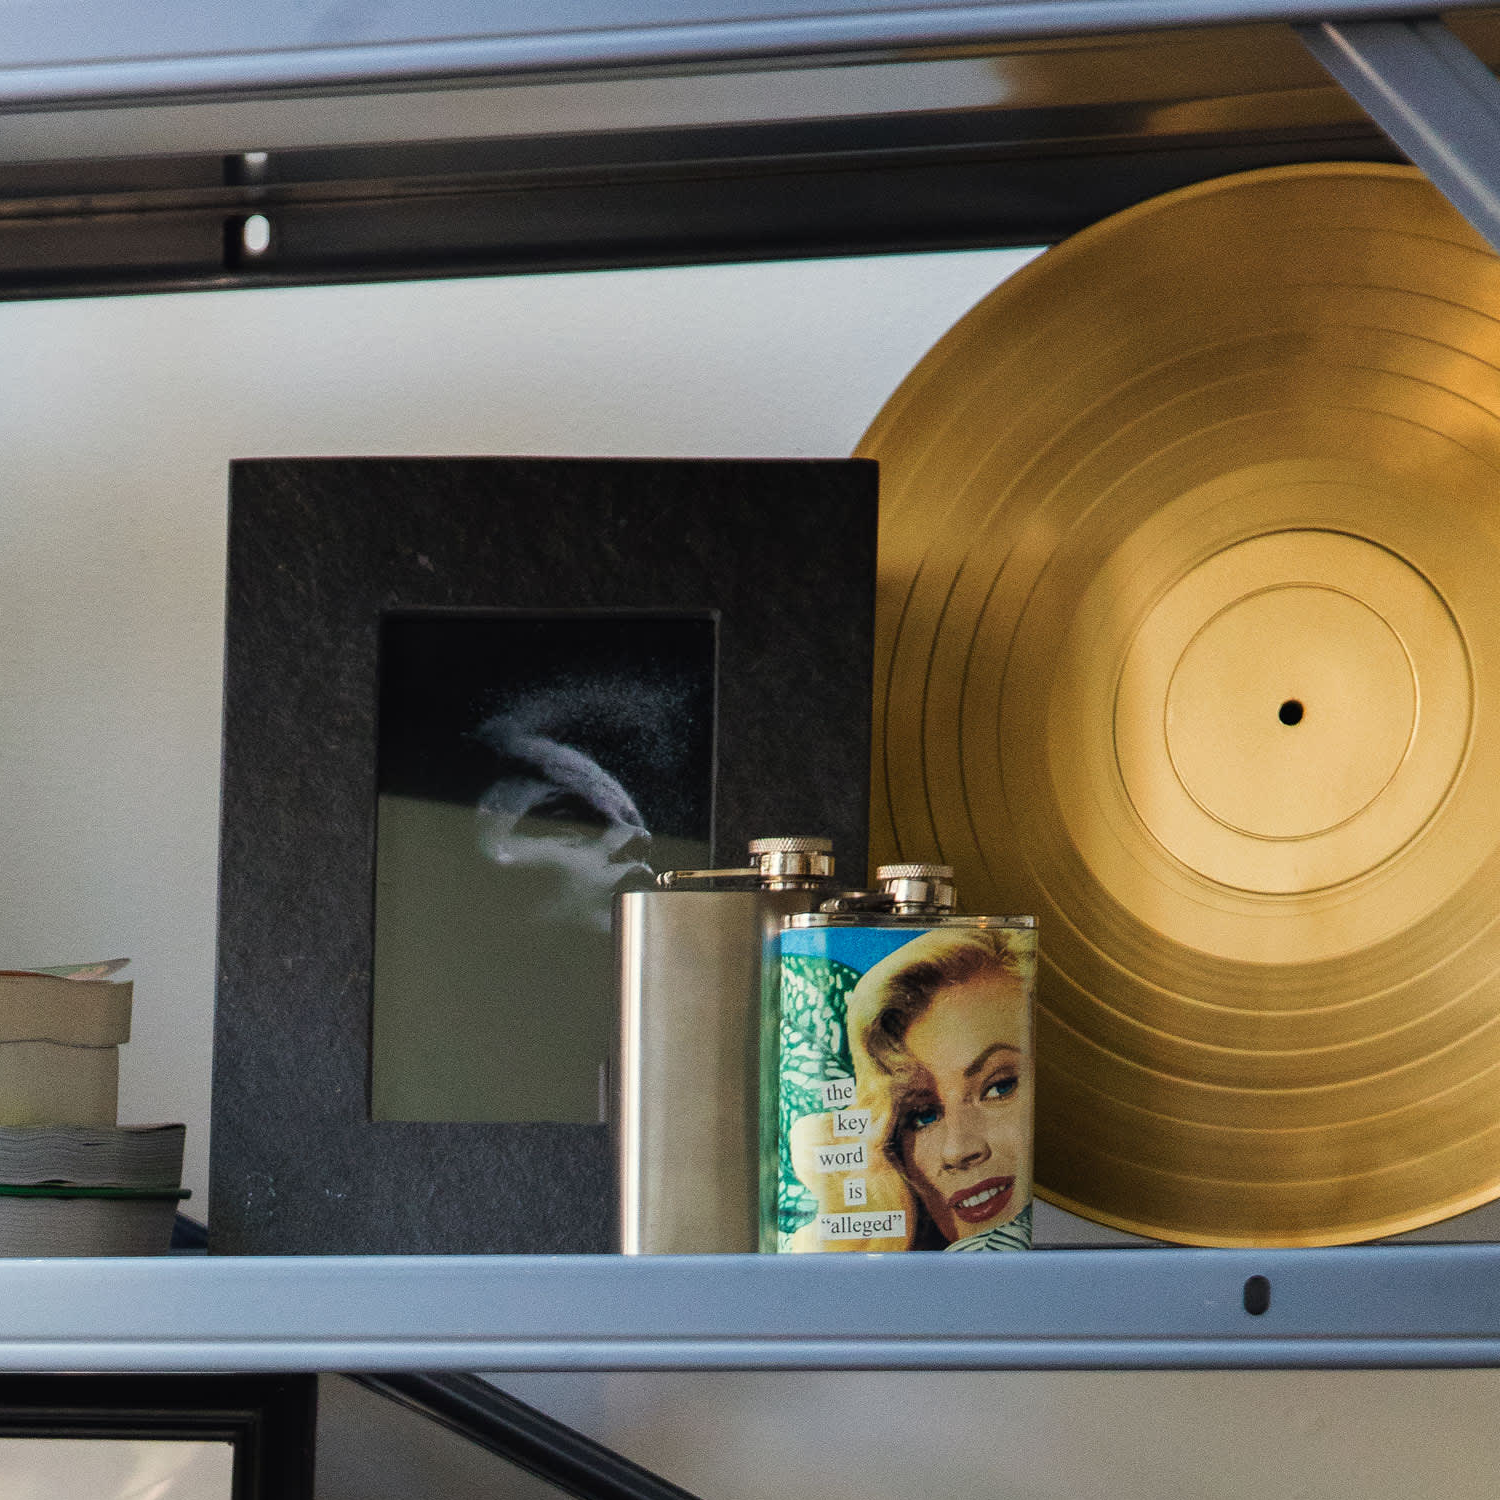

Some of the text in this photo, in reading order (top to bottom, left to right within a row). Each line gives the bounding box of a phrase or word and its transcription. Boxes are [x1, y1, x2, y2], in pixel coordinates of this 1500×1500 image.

[826, 1083, 853, 1102] the
[838, 1113, 868, 1135] key
[819, 1146, 864, 1167] word
[848, 1183, 863, 1200] is
